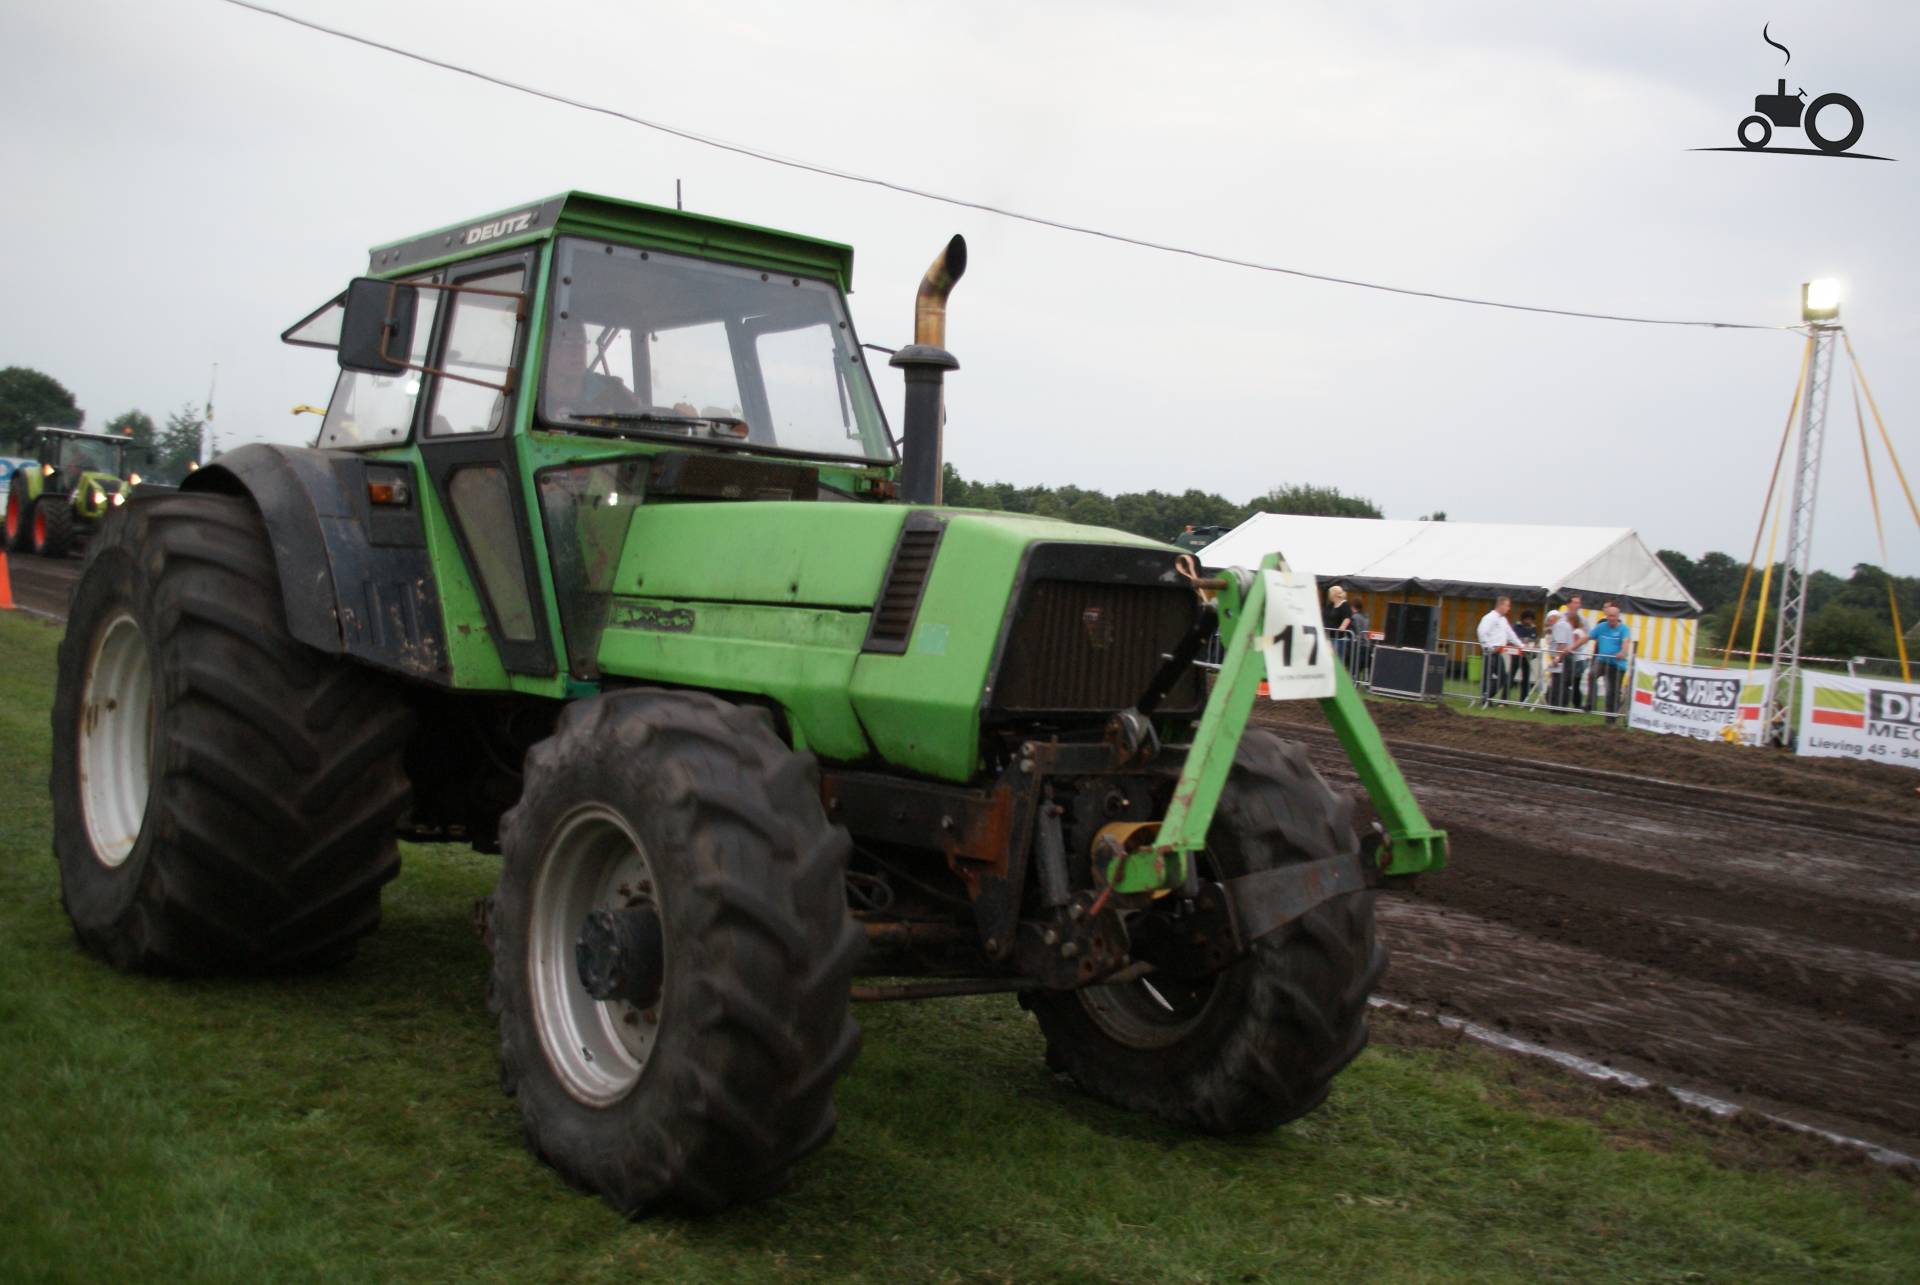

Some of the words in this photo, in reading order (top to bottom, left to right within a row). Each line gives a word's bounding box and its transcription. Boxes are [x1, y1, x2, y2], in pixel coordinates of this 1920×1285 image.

[466, 212, 532, 245] DEUTZ
[1273, 624, 1319, 667] 17
[1659, 675, 1682, 701] DE
[1685, 679, 1736, 707] VRIES
[1653, 701, 1736, 724] MECHANISATIE
[1808, 736, 1864, 755] Lieving
[1867, 744, 1887, 755] 45
